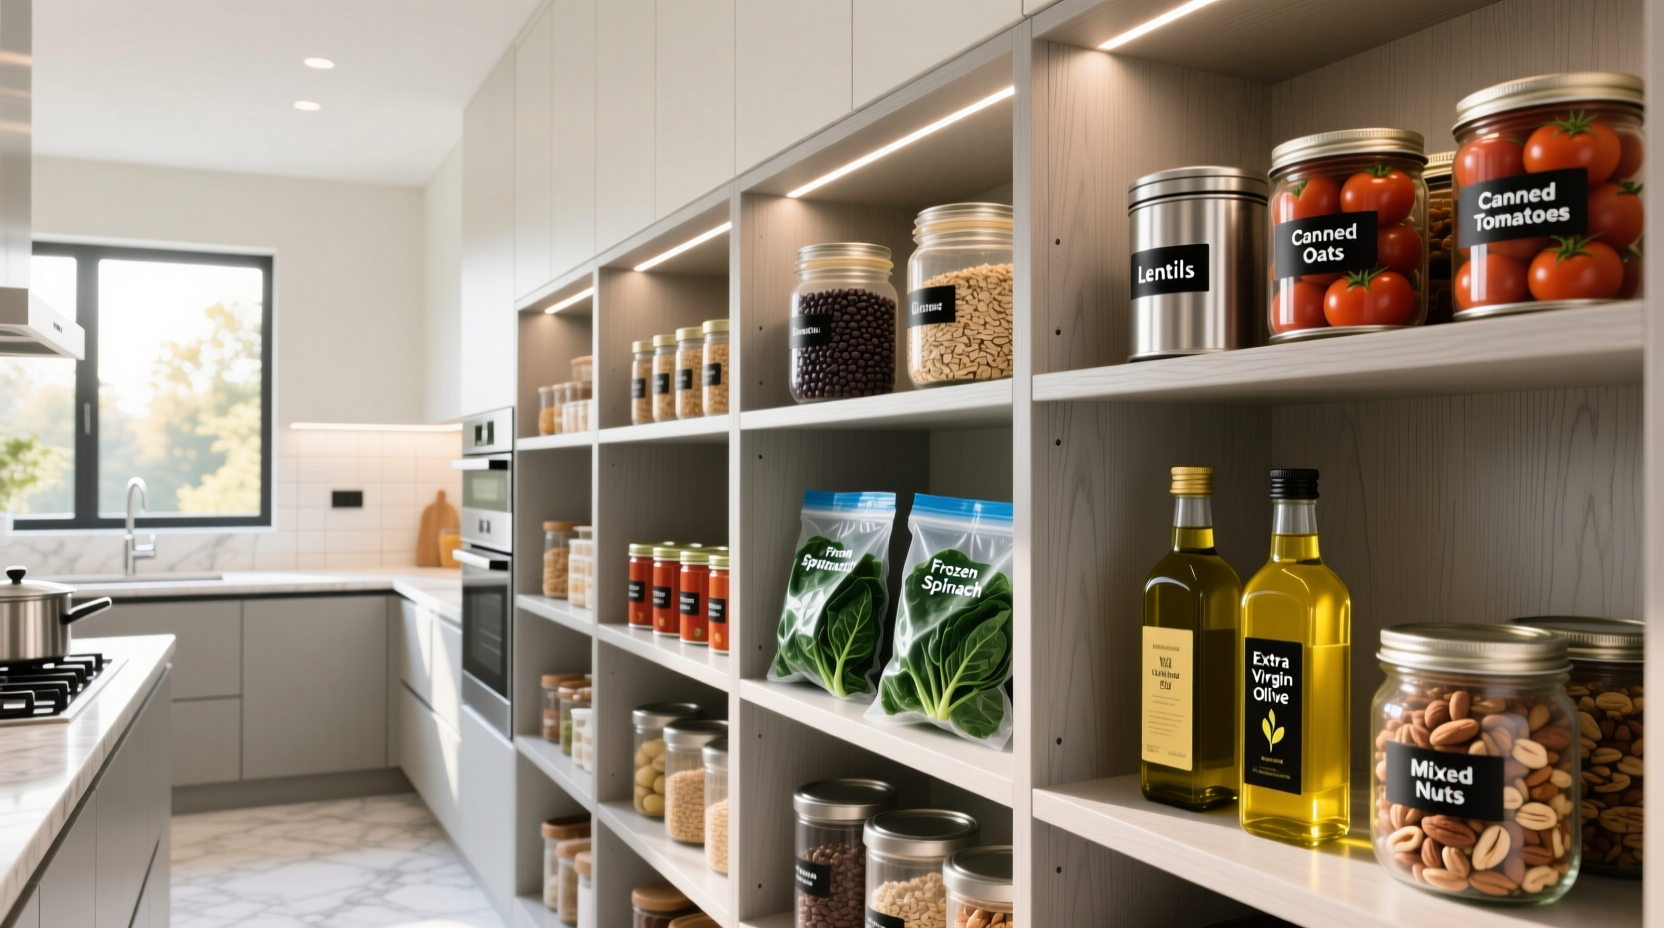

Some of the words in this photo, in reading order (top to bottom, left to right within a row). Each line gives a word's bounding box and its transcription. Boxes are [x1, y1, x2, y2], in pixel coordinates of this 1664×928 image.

[1478, 182, 1556, 210] Canned
[1473, 206, 1570, 232] Tomatoes
[1291, 222, 1357, 246] Canned
[1303, 245, 1345, 264] Oats
[1138, 259, 1195, 284] Lentils
[930, 558, 979, 579] Frozen
[921, 575, 983, 598] Spinach
[1253, 651, 1290, 669] Extra
[1251, 668, 1293, 689] Virgin
[1253, 686, 1290, 705] Olive
[1410, 757, 1474, 786] Mixed
[1415, 780, 1466, 806] Nuts
